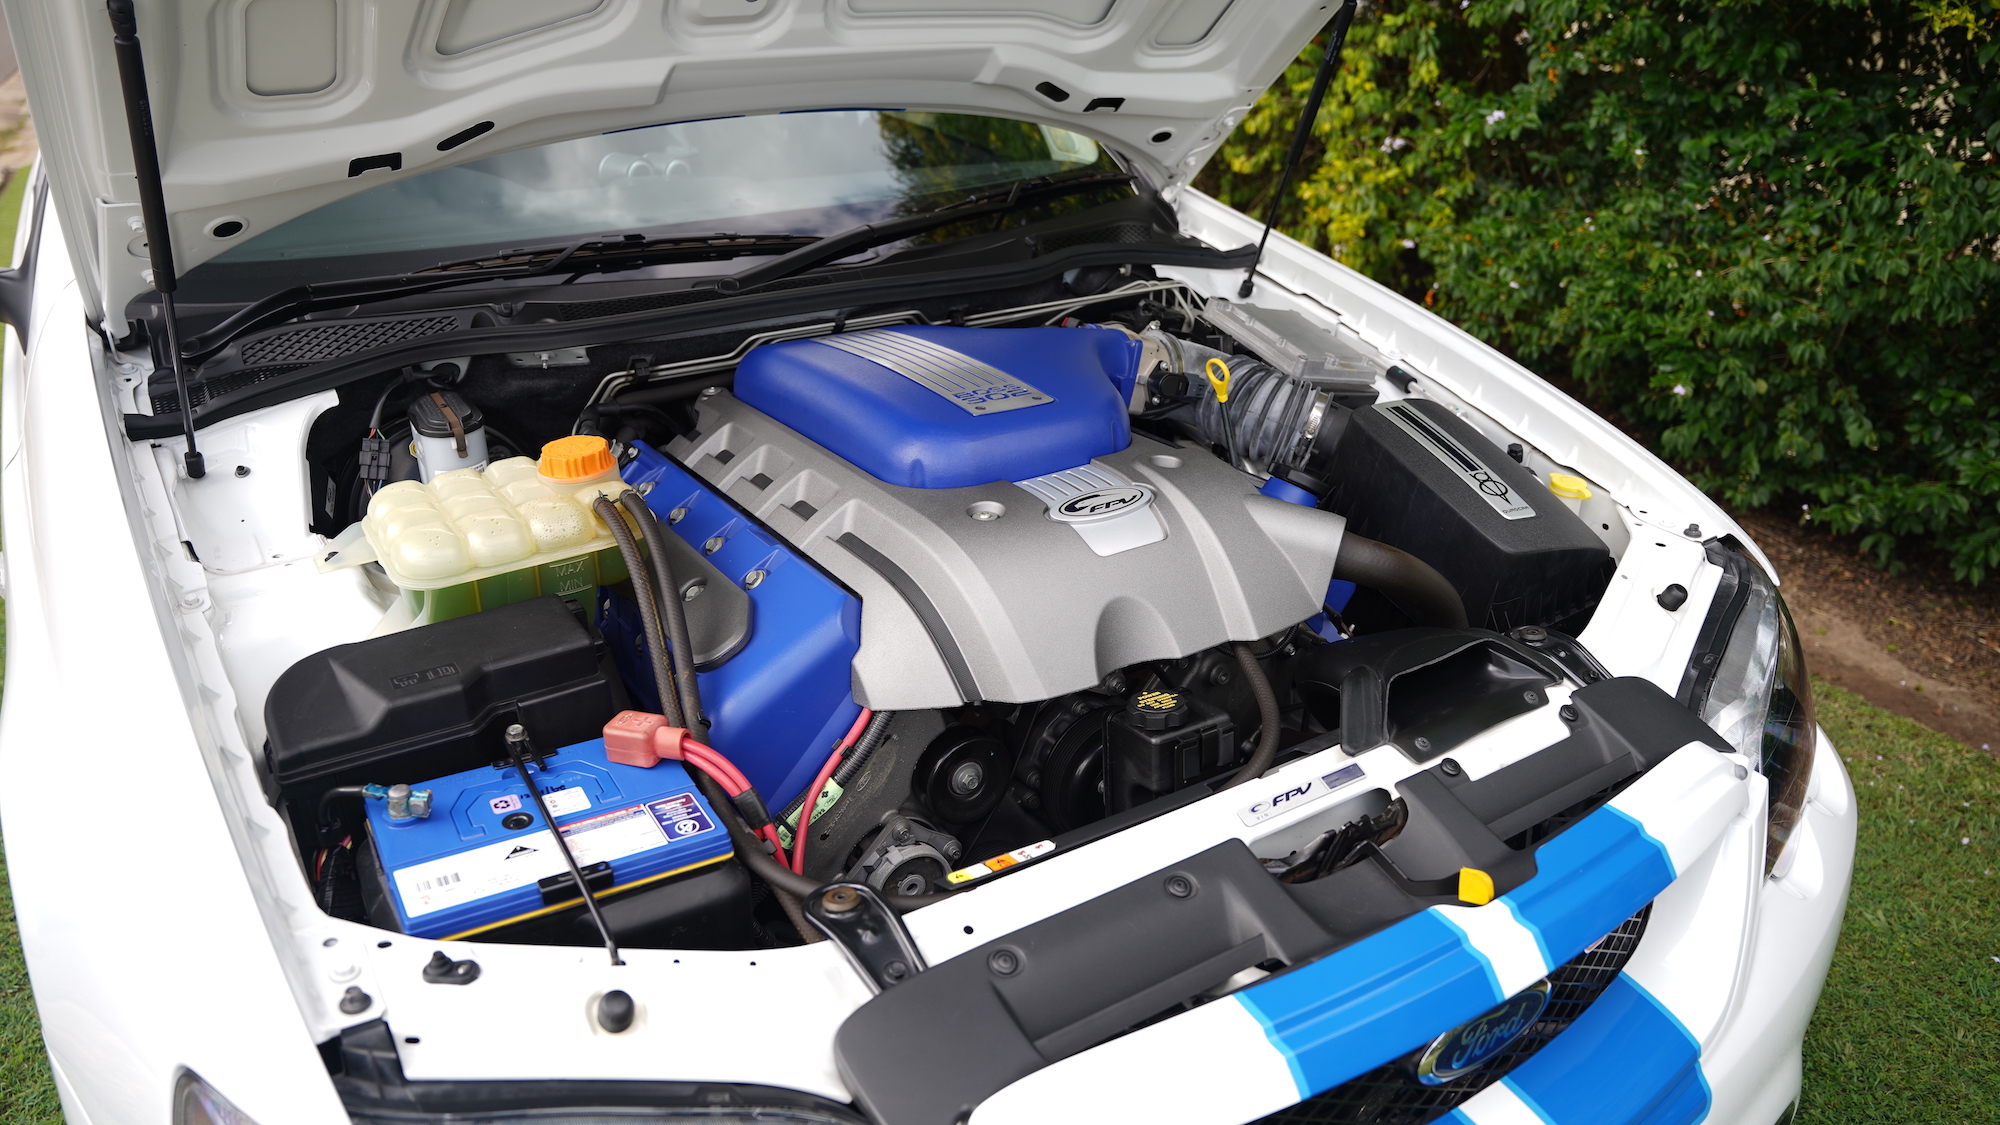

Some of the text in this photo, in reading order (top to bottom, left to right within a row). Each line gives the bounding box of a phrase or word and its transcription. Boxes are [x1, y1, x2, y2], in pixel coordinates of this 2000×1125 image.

[952, 383, 1022, 399] BOSS
[961, 389, 1034, 405] 302
[1089, 494, 1138, 514] FPV
[555, 561, 585, 577] MAX
[560, 577, 584, 592] MIN
[1272, 782, 1313, 808] FPV
[1451, 1002, 1528, 1070] Ford
